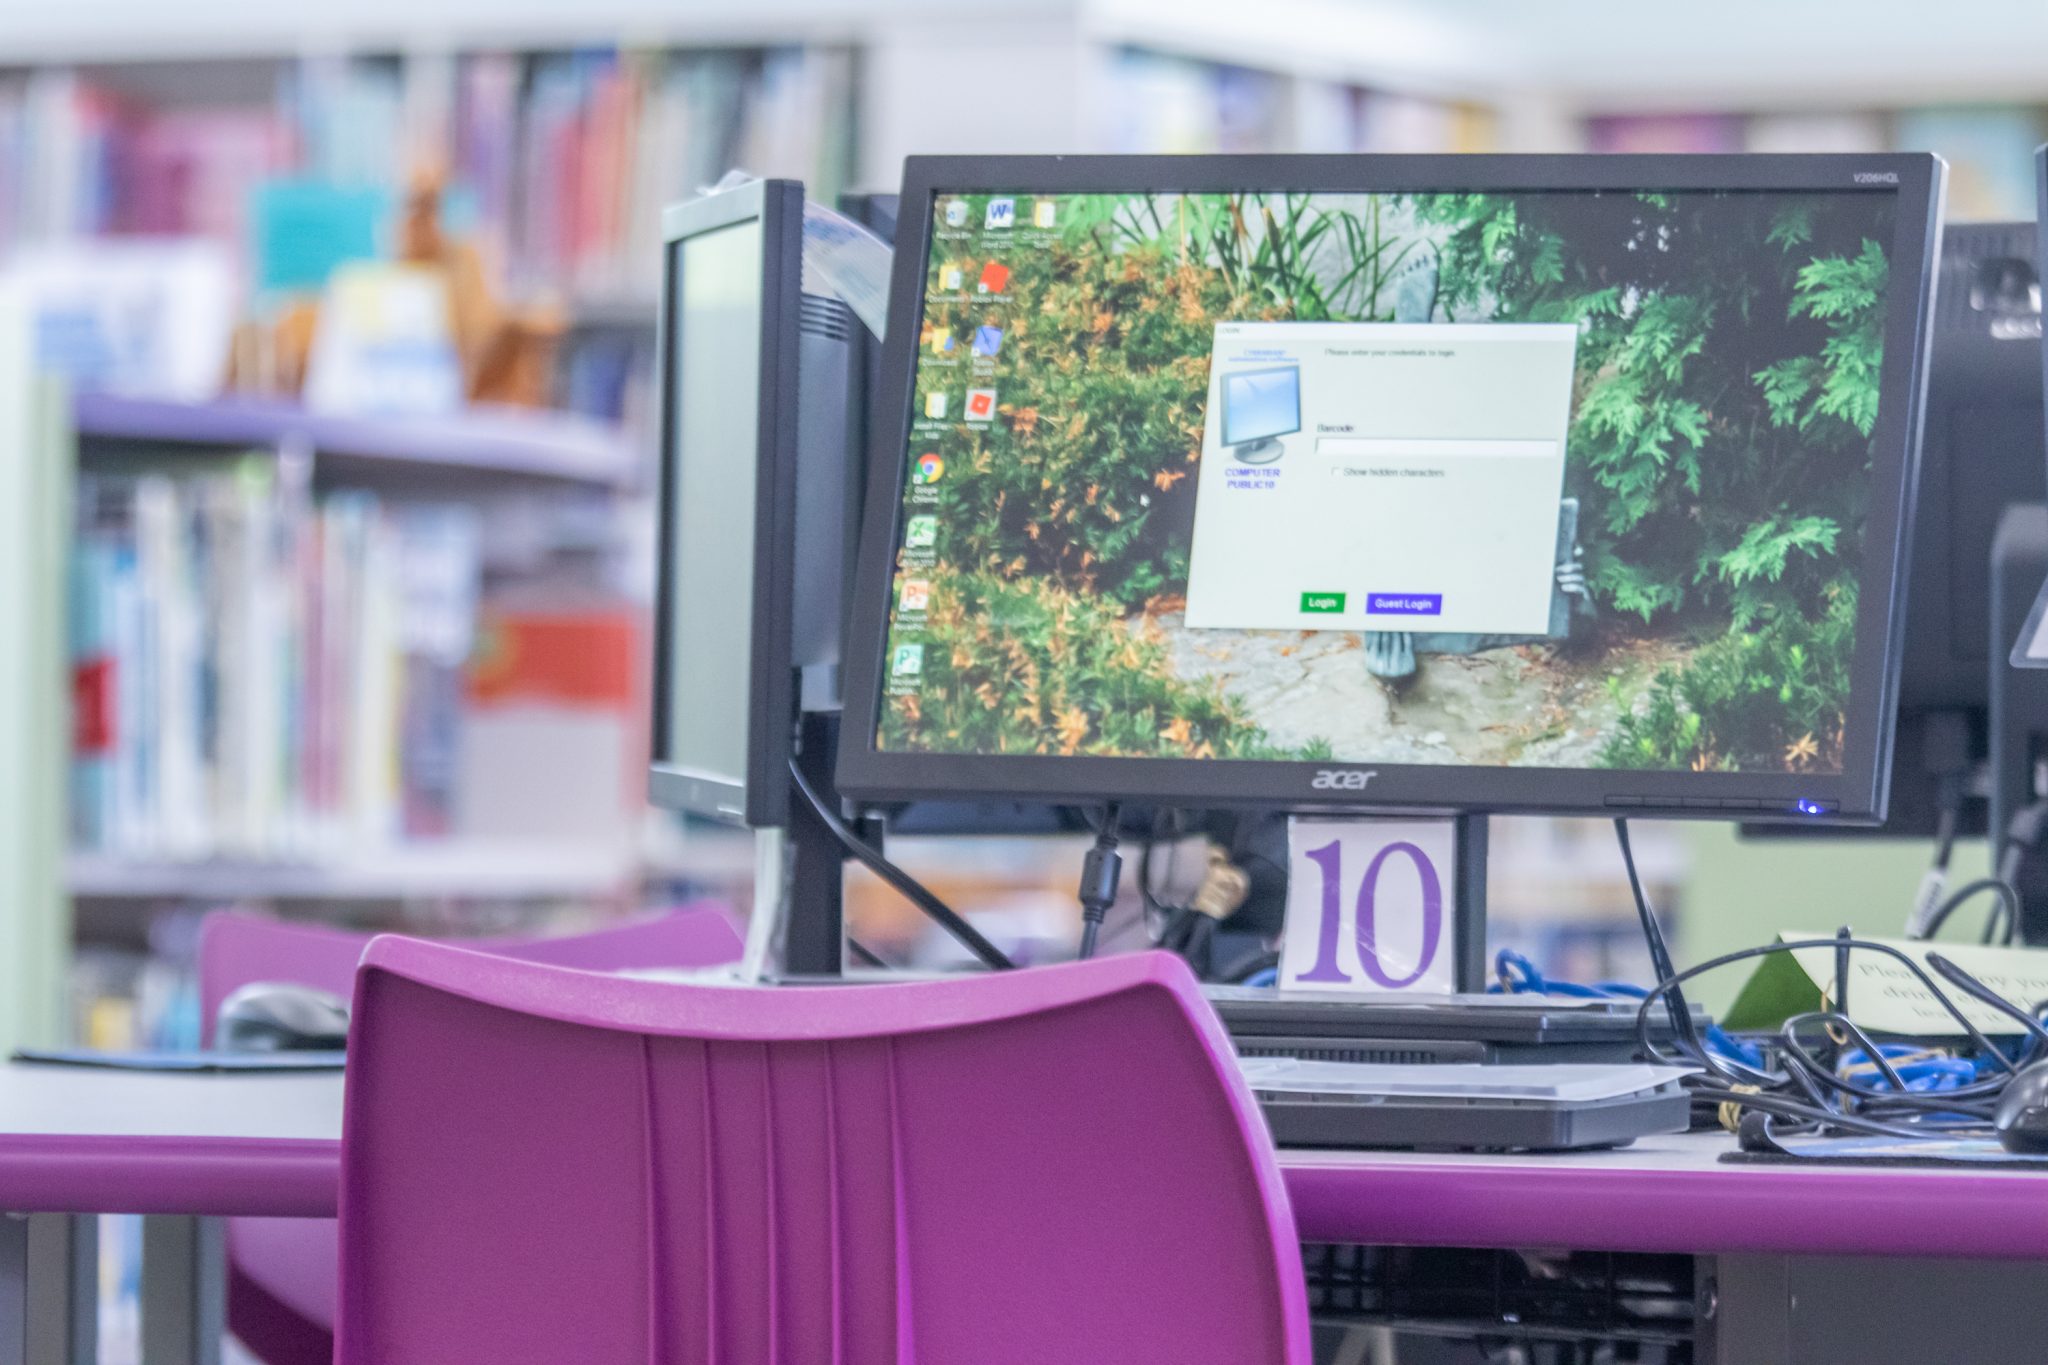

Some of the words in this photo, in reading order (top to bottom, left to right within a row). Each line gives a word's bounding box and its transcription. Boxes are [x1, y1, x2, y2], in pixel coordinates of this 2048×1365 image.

[1853, 173, 1899, 184] V206HQL
[1225, 468, 1281, 478] COMPUTER
[1343, 466, 1367, 478] Show
[1369, 466, 1398, 478] hidden
[1400, 466, 1445, 478] characters
[1308, 597, 1337, 610] Login
[1374, 598, 1403, 610] Guest
[1404, 599, 1433, 611] Login
[1311, 769, 1379, 791] acer
[1295, 838, 1443, 990] 10
